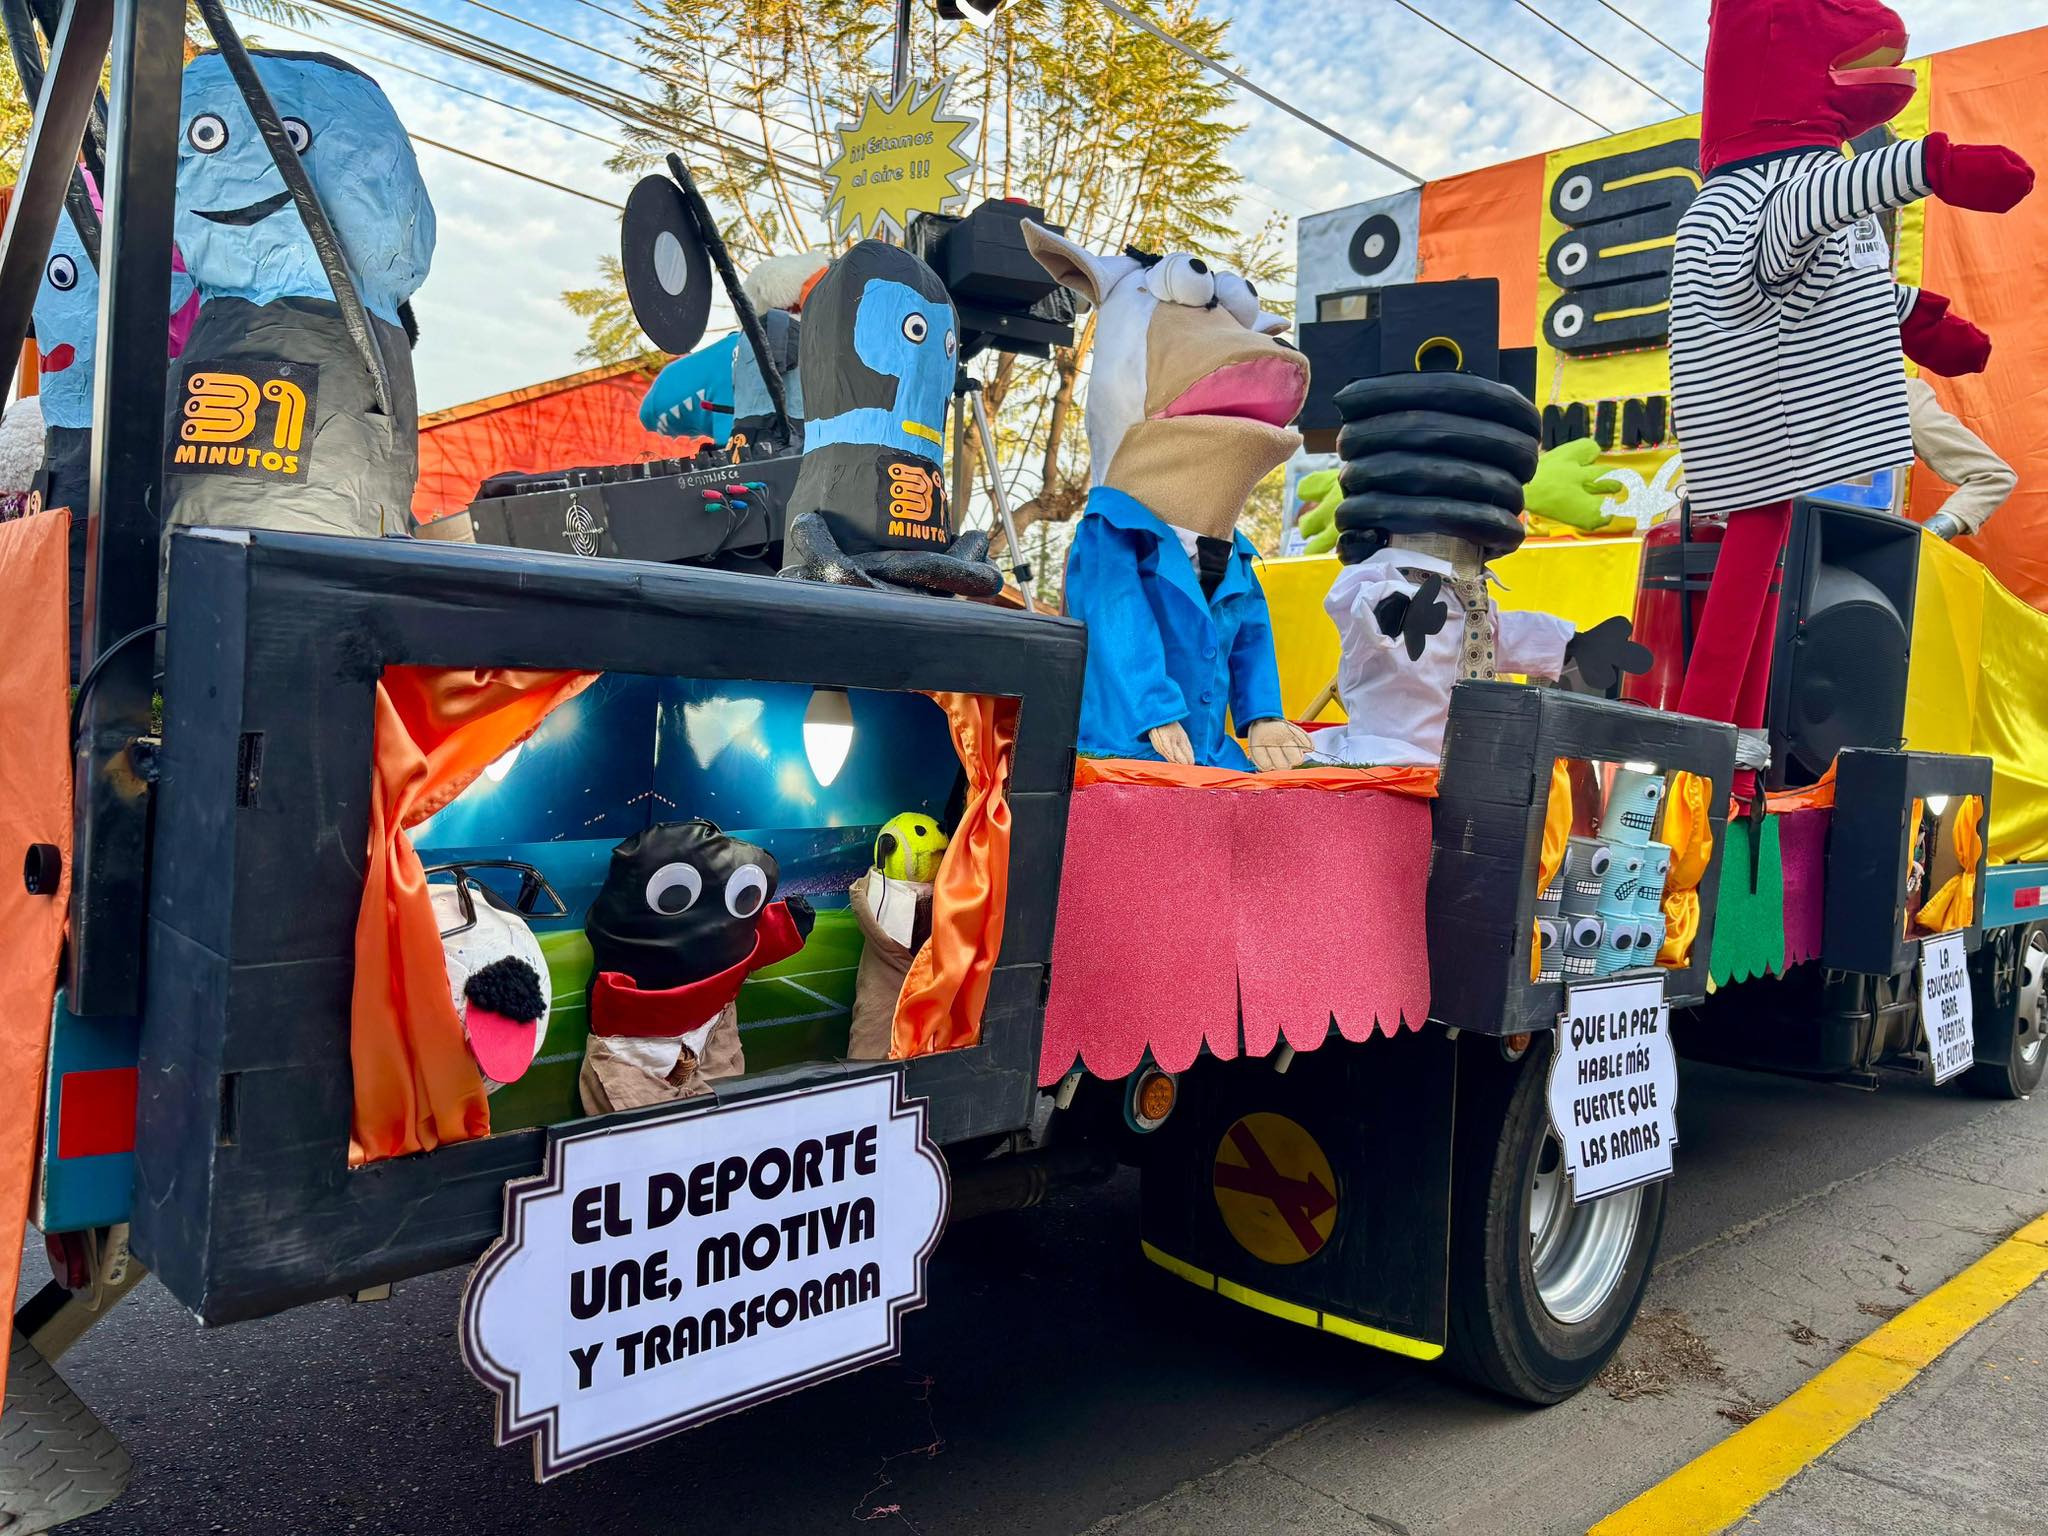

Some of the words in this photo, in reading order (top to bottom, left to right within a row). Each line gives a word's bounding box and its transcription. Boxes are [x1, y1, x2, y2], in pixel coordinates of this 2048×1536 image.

[851, 169, 867, 187] al
[870, 165, 904, 184] aire
[181, 372, 307, 452] 31
[1542, 396, 1676, 452] MIN
[174, 444, 299, 474] MINUTOS
[1939, 948, 1949, 970] LA
[1926, 965, 1965, 1000] EDUCACIÓN
[1570, 1014, 1605, 1051] QUE
[1609, 1011, 1627, 1040] LA
[1630, 1006, 1659, 1037] PAZ
[1940, 995, 1959, 1020] ABRE
[1937, 1016, 1966, 1047] PUERTAS
[1578, 1053, 1623, 1085] HABLE
[1625, 1042, 1650, 1075] MÁS
[1936, 1053, 1946, 1073] AL
[1946, 1041, 1972, 1068] FUTURO
[1573, 1091, 1626, 1127] FUERTE
[1627, 1082, 1658, 1116] QUE
[1580, 1134, 1608, 1168] LAS
[1610, 1121, 1661, 1160] ARMAS
[571, 1181, 632, 1245] EL
[647, 1124, 878, 1230] DEPORTE
[570, 1251, 682, 1320] UNE,
[696, 1196, 875, 1288] MOTIVA
[568, 1341, 604, 1391] Y
[616, 1261, 881, 1377] TRANSFORMA
